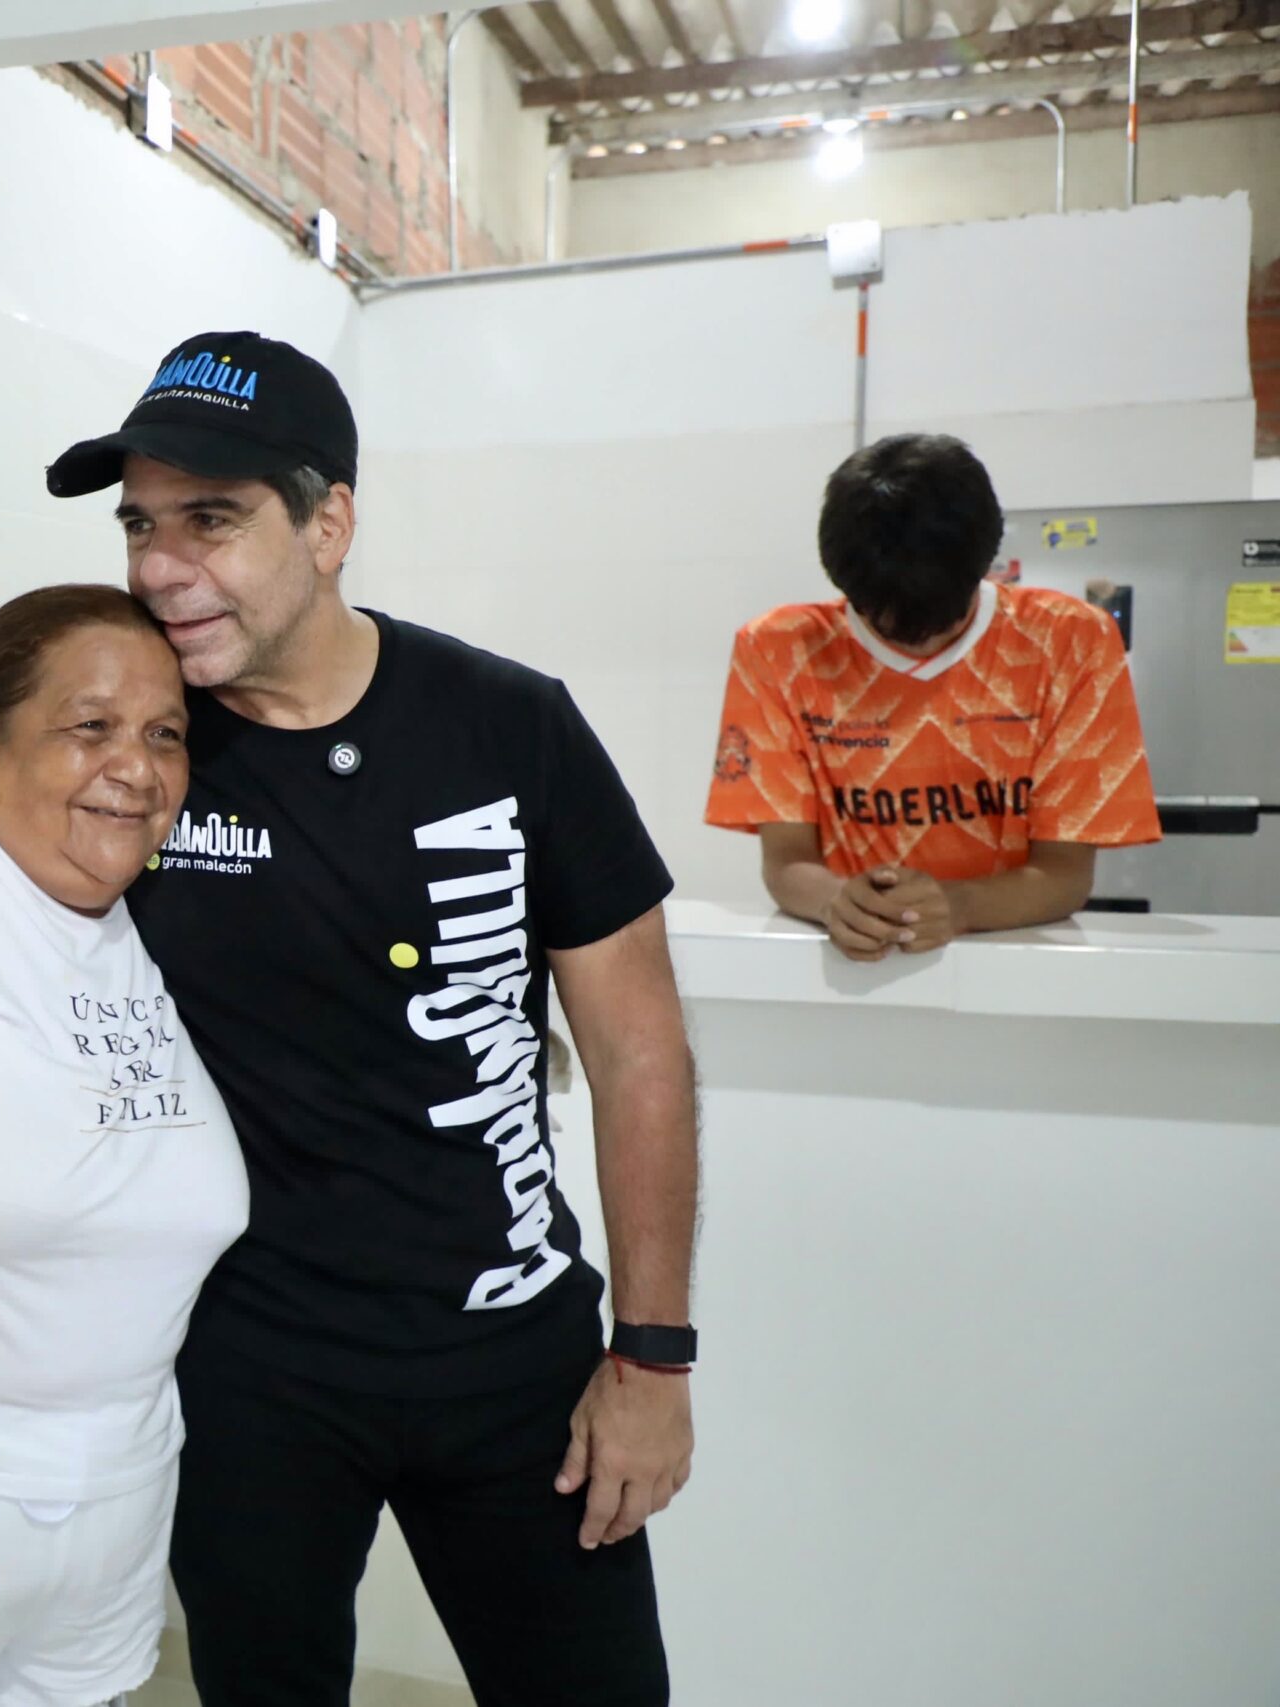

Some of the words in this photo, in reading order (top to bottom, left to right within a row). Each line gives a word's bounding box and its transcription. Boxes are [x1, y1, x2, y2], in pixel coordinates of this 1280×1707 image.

[146, 350, 258, 401] ANQUILLA
[161, 810, 272, 858] RANQUILLA
[162, 856, 191, 870] gran
[193, 859, 252, 874] malecón
